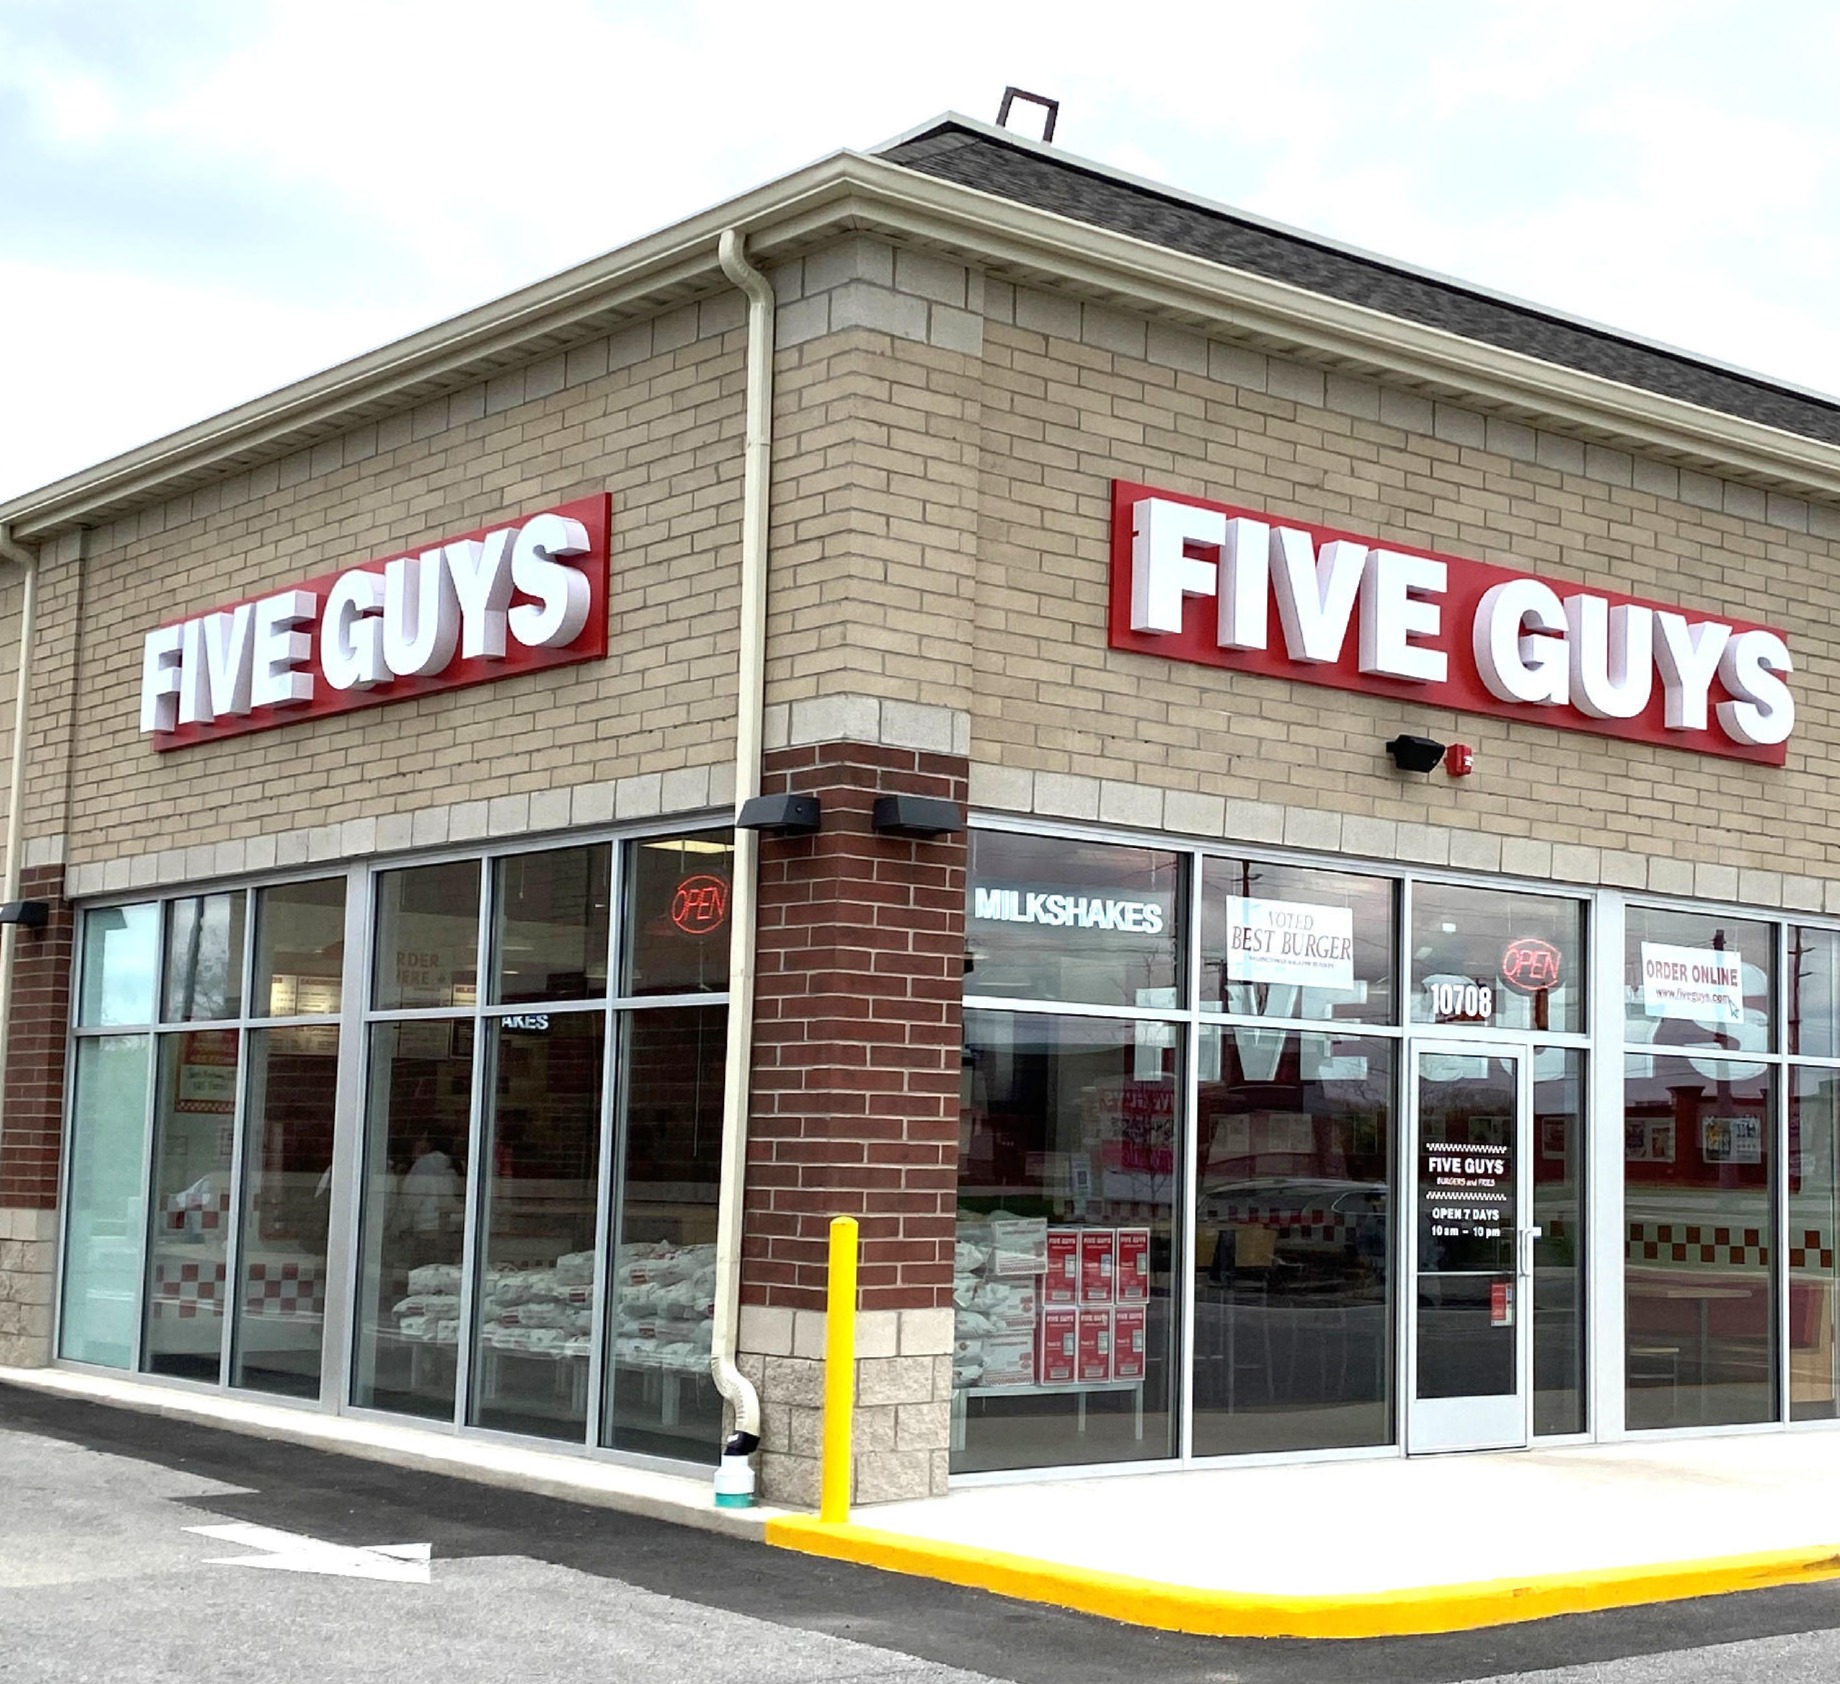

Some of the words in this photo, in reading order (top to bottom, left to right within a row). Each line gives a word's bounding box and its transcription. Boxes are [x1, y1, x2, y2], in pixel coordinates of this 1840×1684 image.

[140, 589, 317, 734] FIVE
[320, 513, 591, 690] GUYS
[1130, 496, 1448, 683] FIVE
[1473, 578, 1796, 746] GUYS
[672, 887, 728, 921] OPEN
[975, 887, 1163, 934] MILKSHAKES
[1269, 911, 1315, 931] VOTED
[1231, 926, 1276, 953] BEST
[1281, 931, 1351, 960] BURGER
[1502, 948, 1562, 980] OPEN
[1646, 959, 1688, 983] ORDER
[1691, 965, 1738, 987] ONLINE
[1431, 982, 1492, 1018] 10708
[1428, 1156, 1461, 1173] FIVE
[1464, 1157, 1504, 1175] GUYS
[1432, 1207, 1462, 1219] OPEN
[1463, 1208, 1471, 1220] 7
[1472, 1208, 1500, 1221] DAYS
[1431, 1225, 1443, 1236] 10
[1443, 1227, 1459, 1236] am
[1472, 1226, 1484, 1237] 10
[1485, 1227, 1502, 1239] pm
